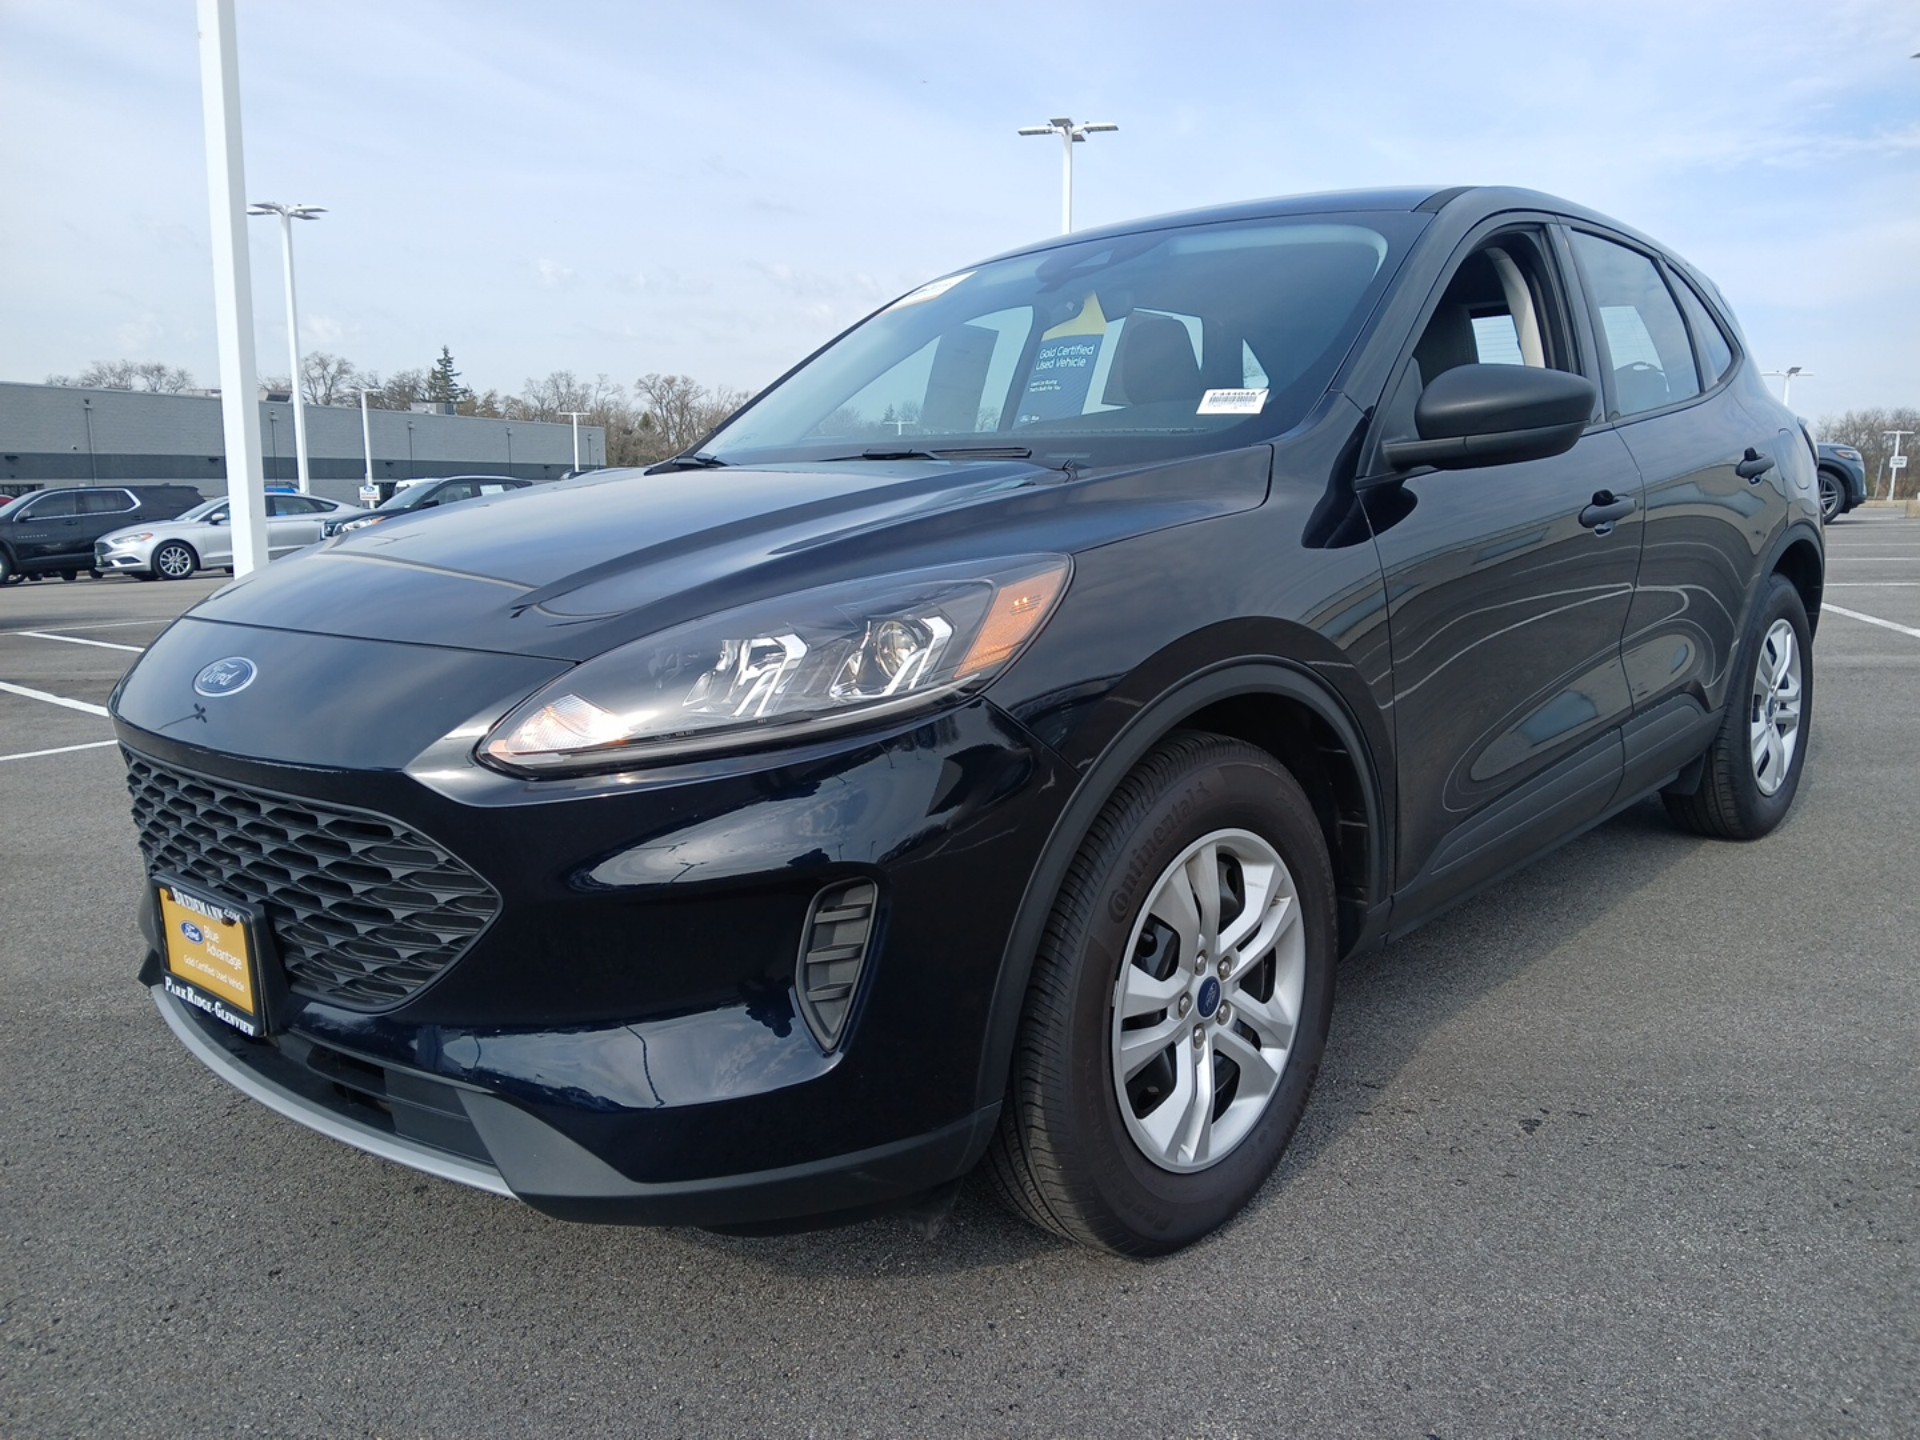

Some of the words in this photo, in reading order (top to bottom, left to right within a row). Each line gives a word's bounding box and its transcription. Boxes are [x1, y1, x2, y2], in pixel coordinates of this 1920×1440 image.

[1040, 348, 1057, 360] Gold
[1057, 344, 1095, 356] Certified
[1035, 359, 1055, 371] Used
[1056, 357, 1086, 368] Vehicle
[199, 659, 243, 689] Ford
[183, 922, 202, 942] Ford
